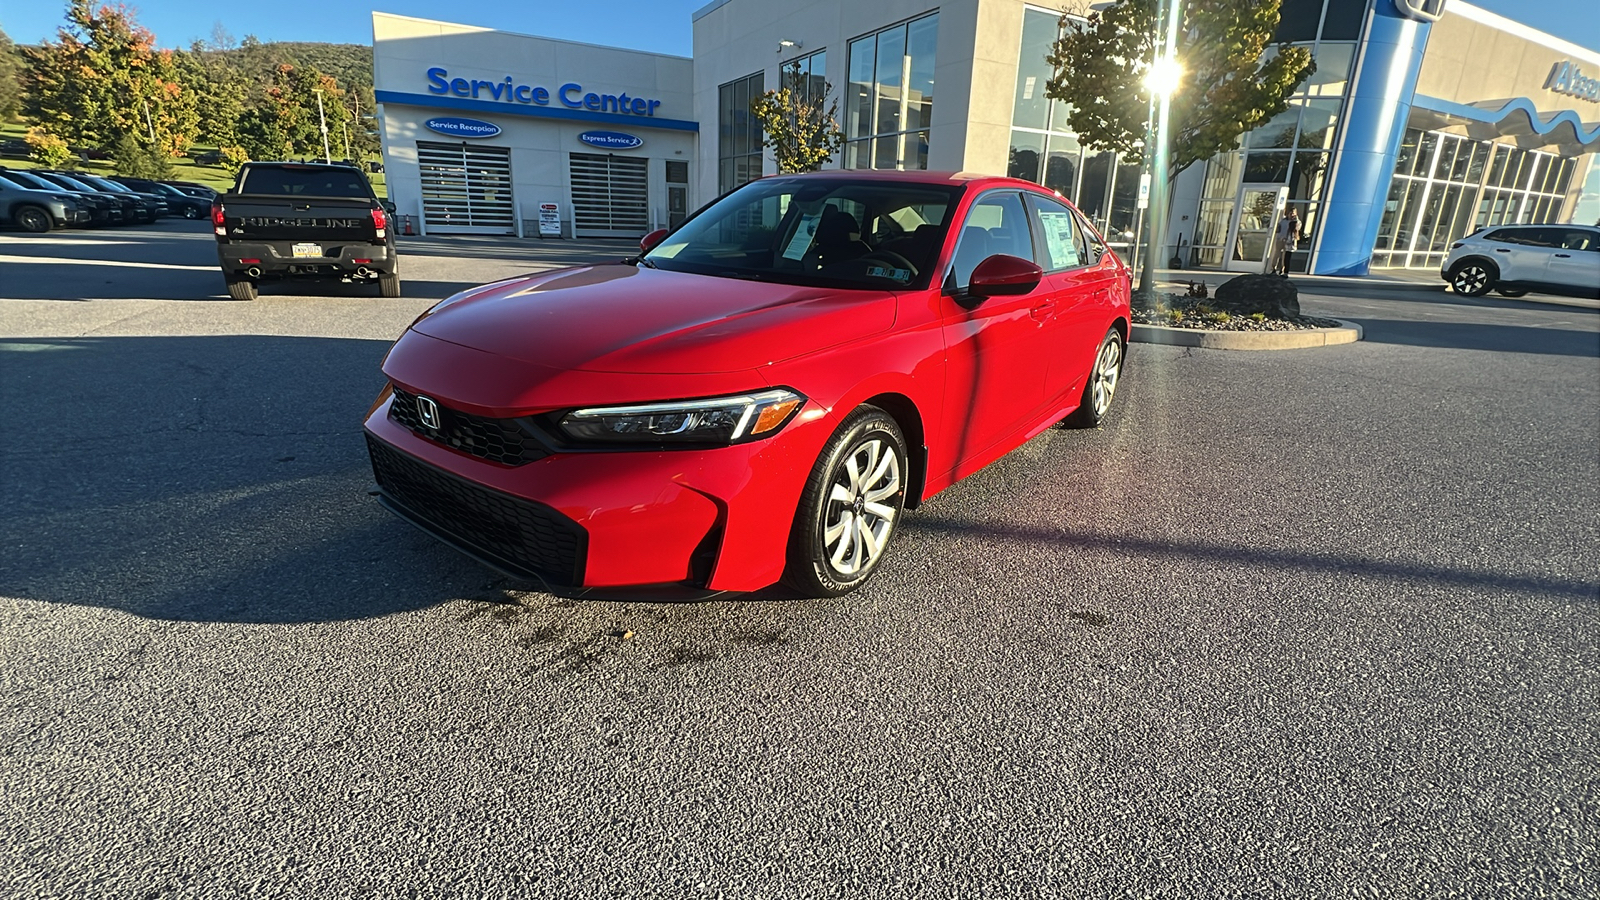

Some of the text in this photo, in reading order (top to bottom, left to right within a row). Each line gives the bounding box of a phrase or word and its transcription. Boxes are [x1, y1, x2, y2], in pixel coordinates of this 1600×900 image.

[427, 67, 661, 116] Service Center
[430, 121, 497, 133] Service Reception
[582, 134, 630, 145] Express Service
[239, 217, 362, 228] RIDGELINE
